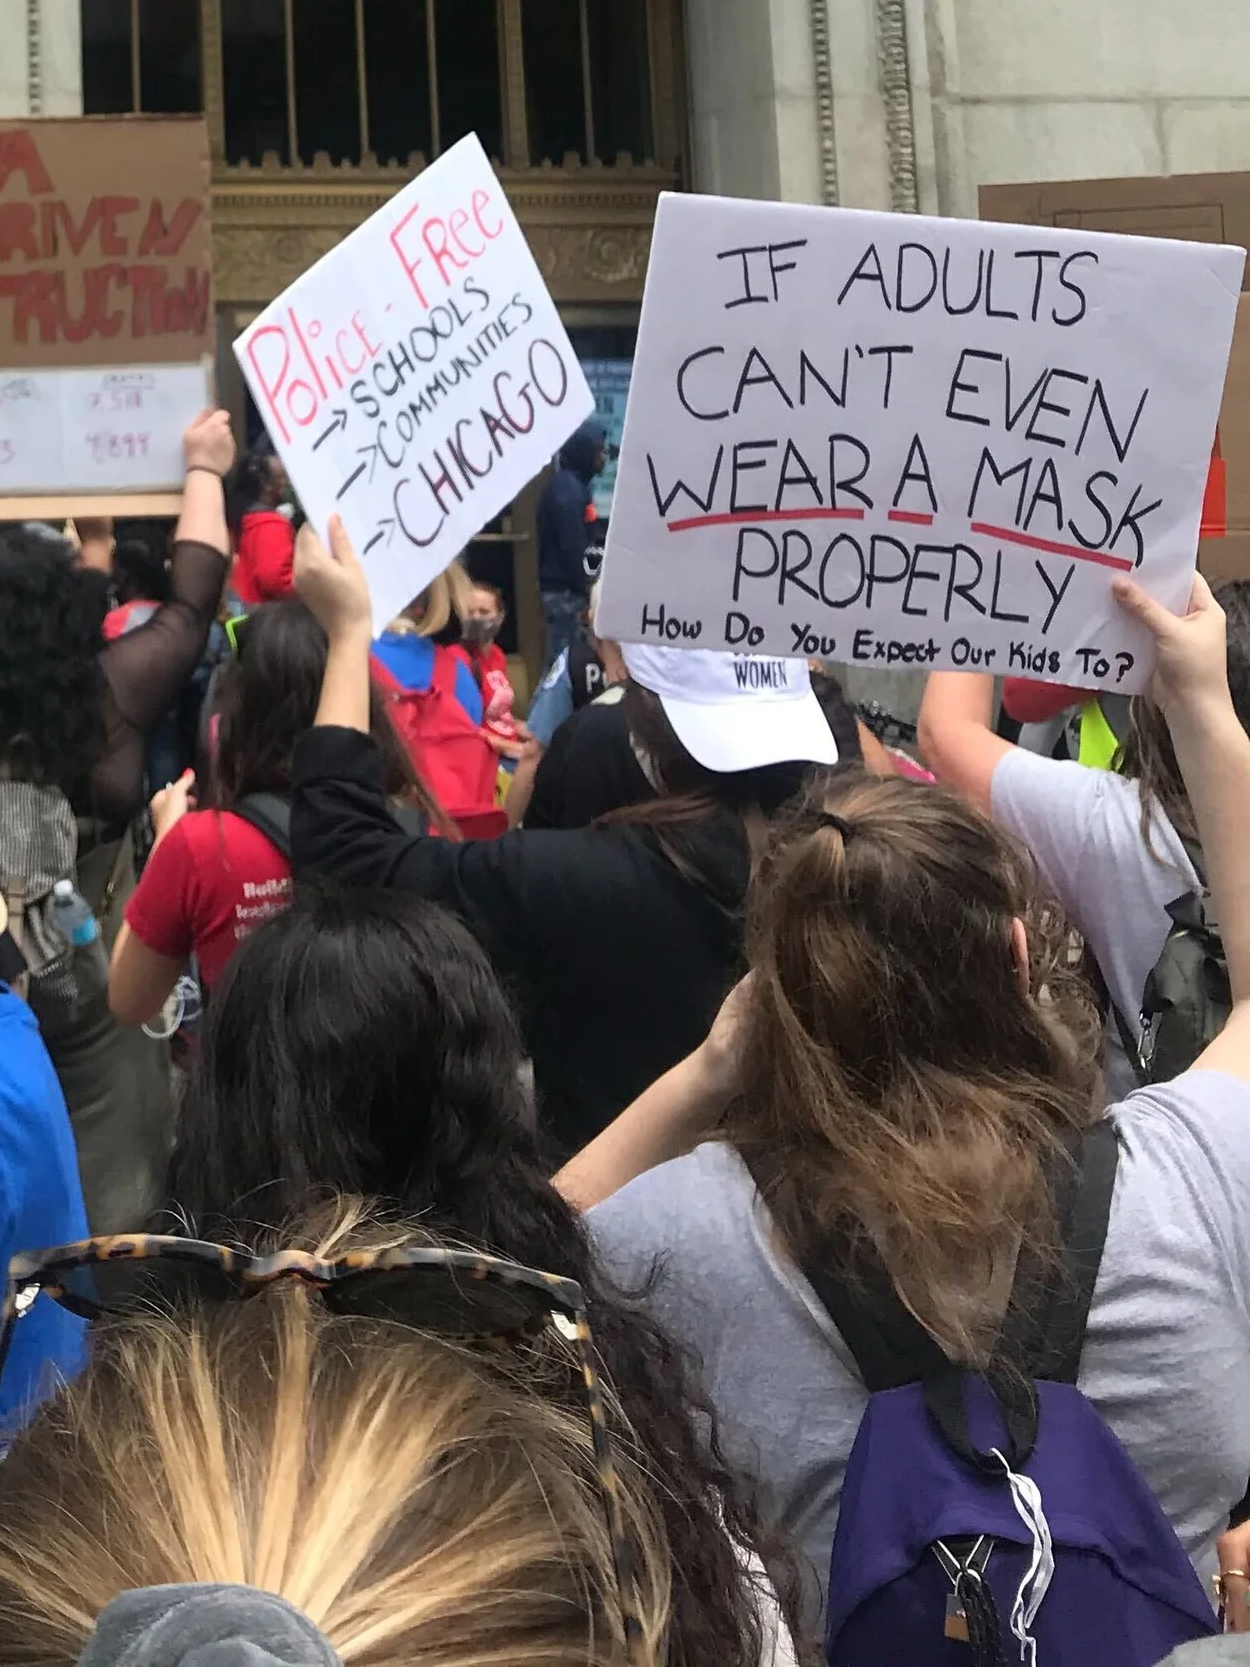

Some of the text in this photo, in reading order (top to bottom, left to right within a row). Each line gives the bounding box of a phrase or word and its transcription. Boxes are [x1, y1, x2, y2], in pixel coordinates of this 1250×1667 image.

[717, 239, 1099, 326] IF ADULTS
[350, 276, 490, 418] SCHOOLS
[377, 292, 532, 468] COMMUNITIES
[677, 345, 1148, 462] CAN'T EVEN
[393, 338, 567, 546] CHICAGO
[647, 433, 1163, 569] WEAR A MASK
[733, 528, 1075, 634] PROPERLY
[642, 604, 1134, 683] How Do You Expect Our Kids To?
[734, 660, 787, 688] WOMEN
